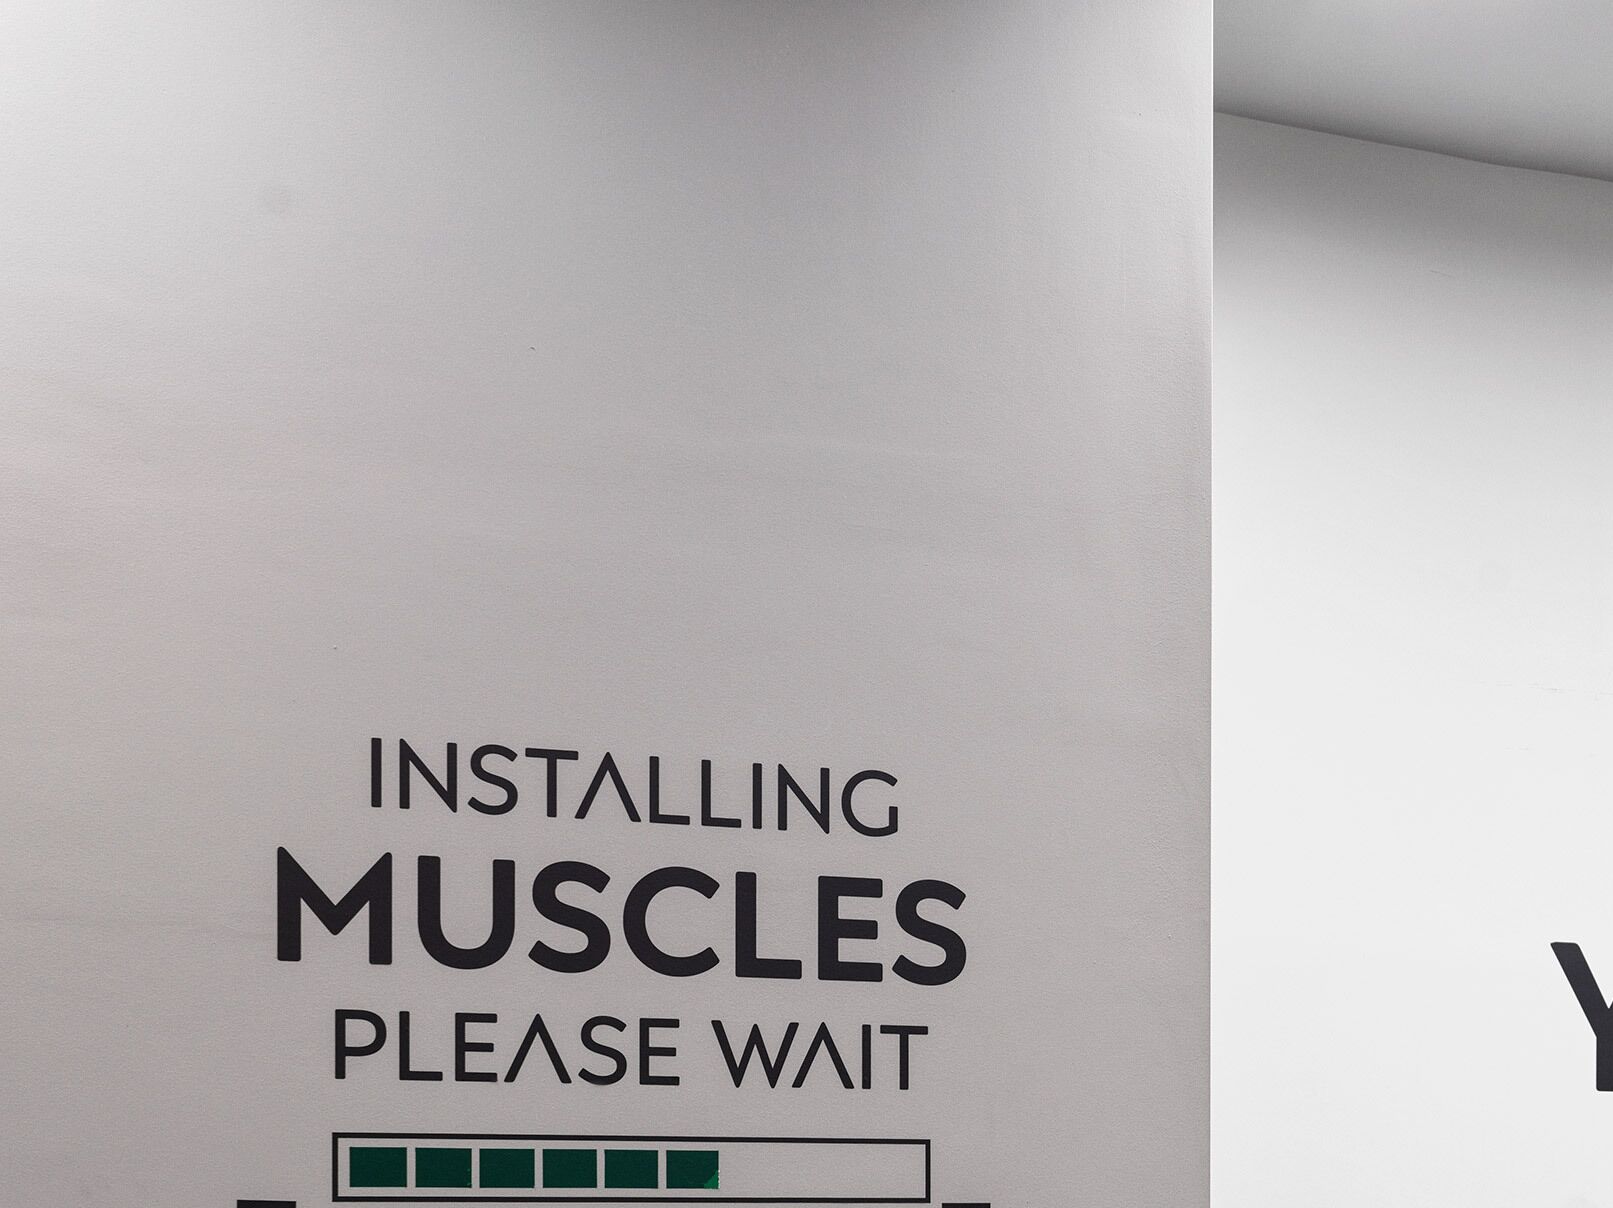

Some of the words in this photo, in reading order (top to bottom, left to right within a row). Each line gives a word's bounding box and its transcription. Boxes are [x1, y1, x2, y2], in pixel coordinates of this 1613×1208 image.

[369, 737, 899, 838] INSTALLING
[276, 846, 968, 987] MUSCLES
[334, 1009, 681, 1087] PLEASE
[711, 1019, 930, 1091] WAIT
